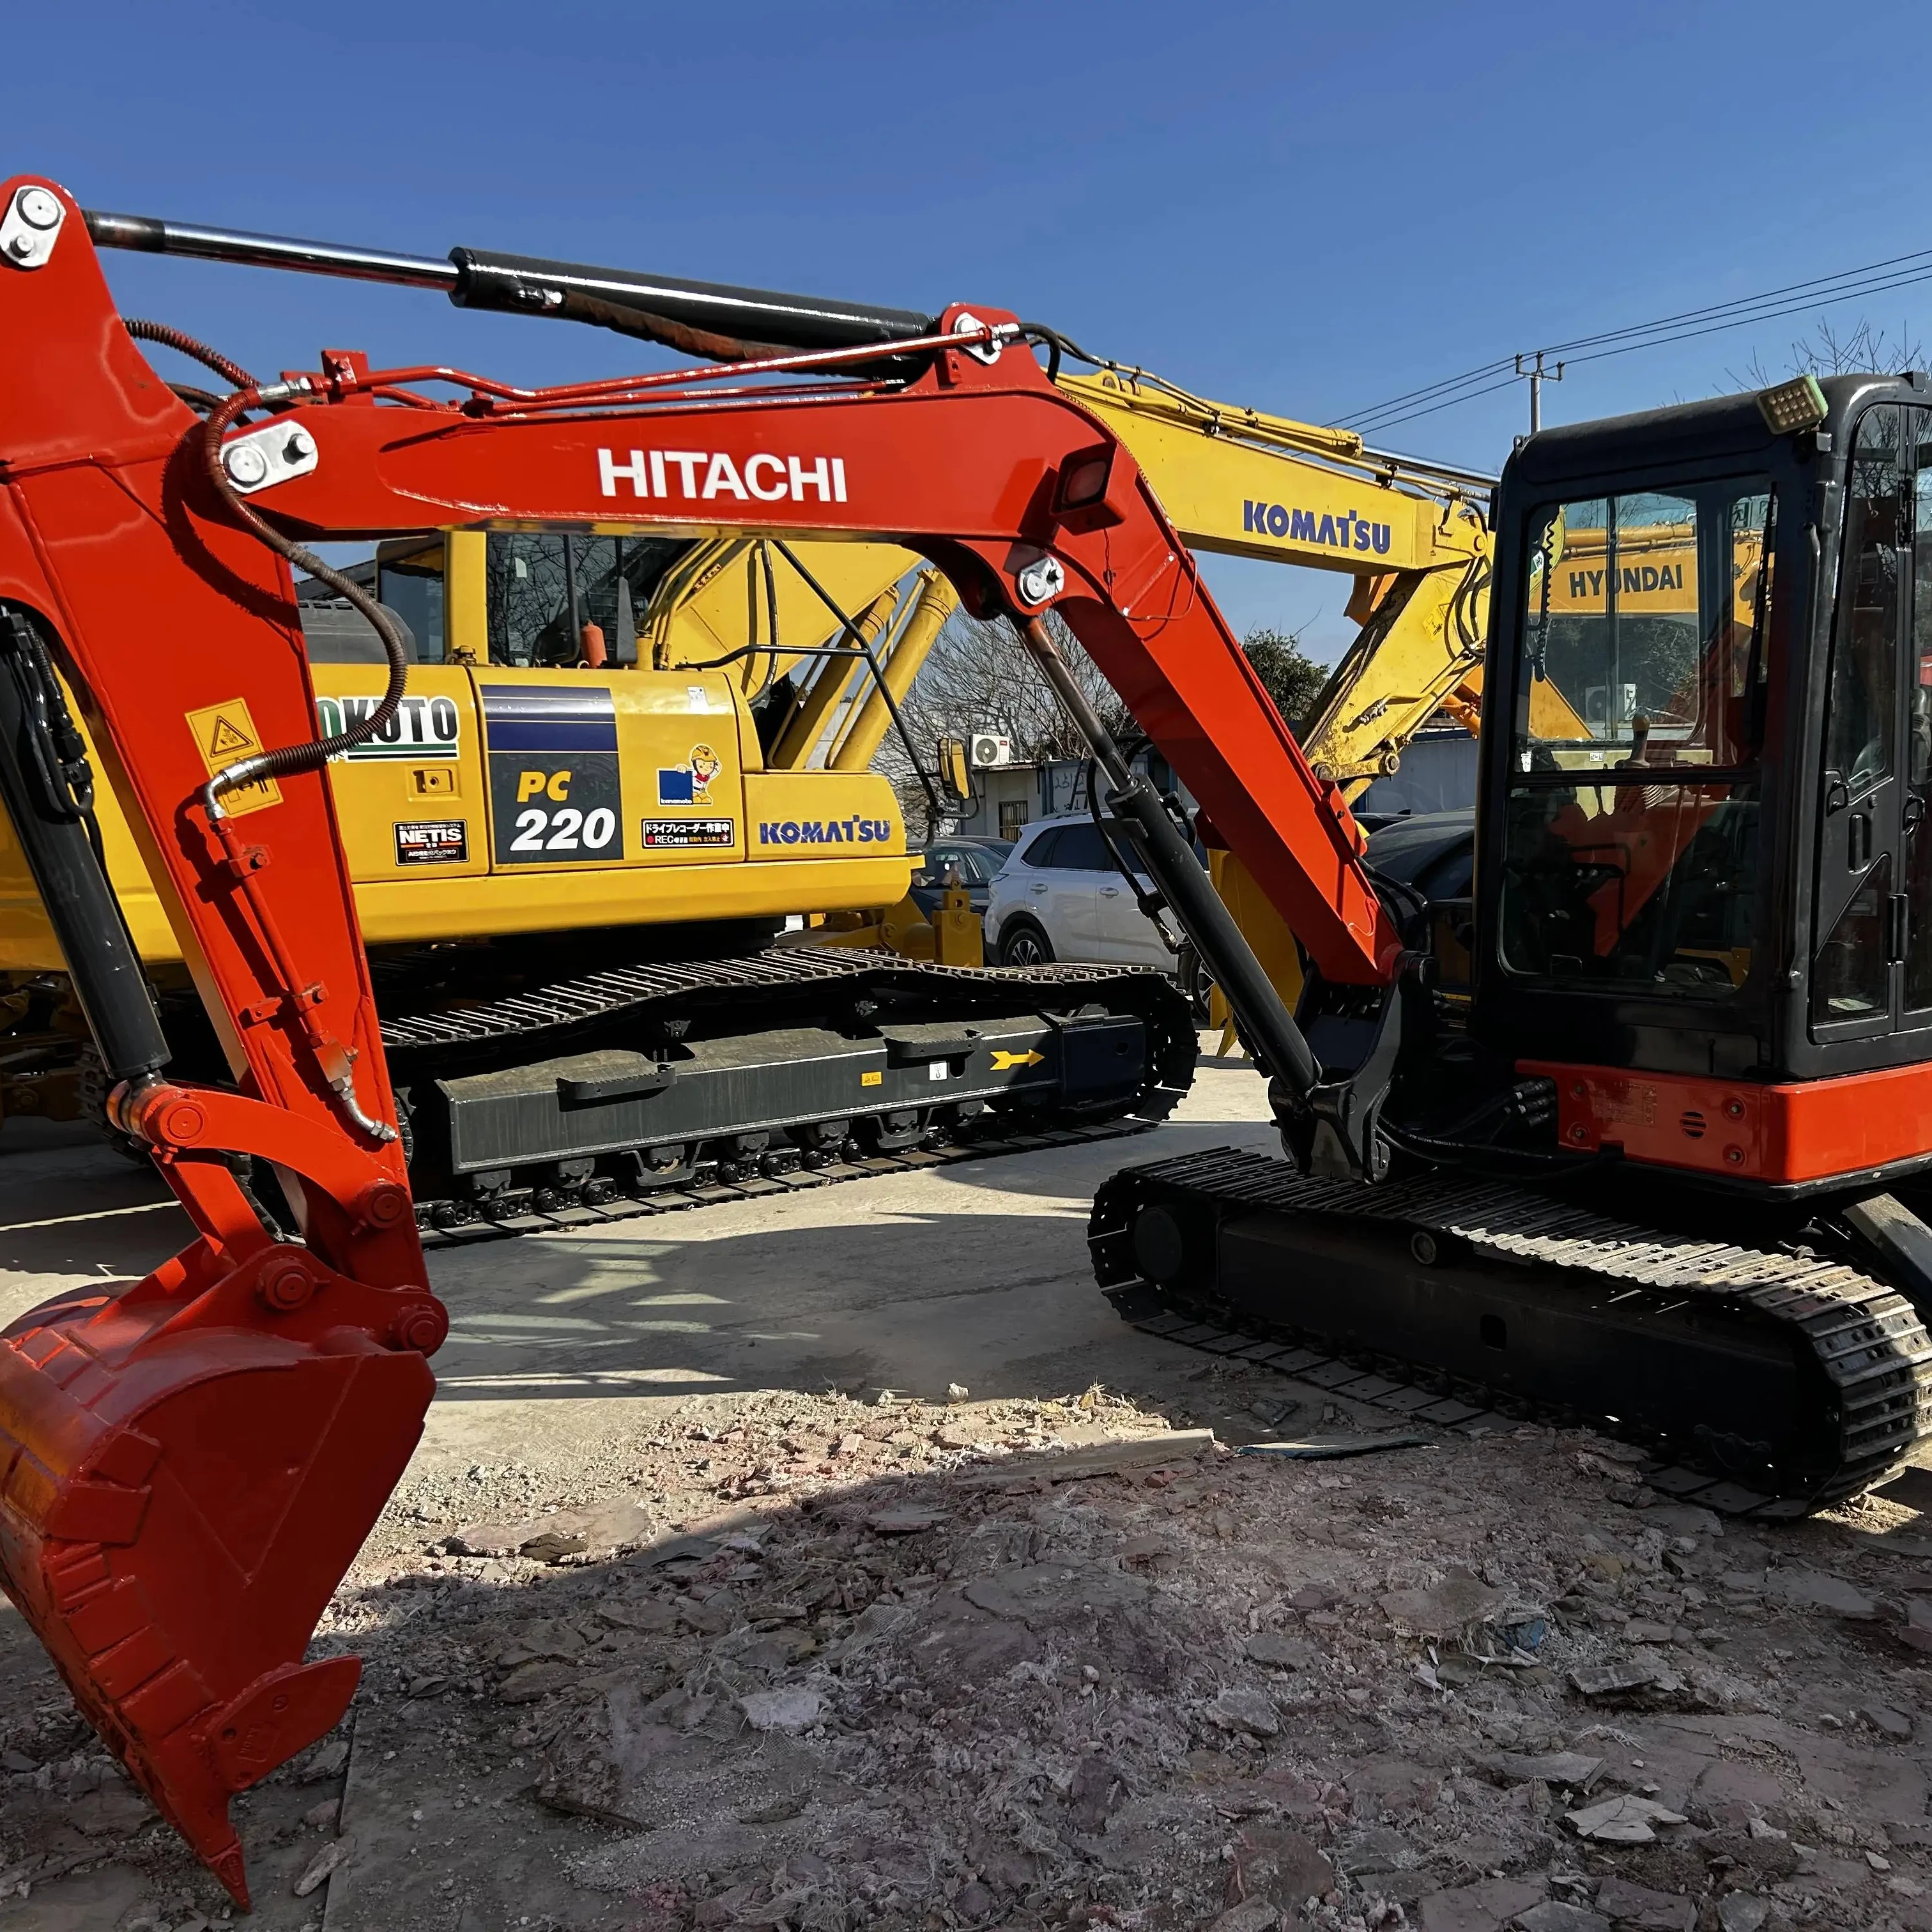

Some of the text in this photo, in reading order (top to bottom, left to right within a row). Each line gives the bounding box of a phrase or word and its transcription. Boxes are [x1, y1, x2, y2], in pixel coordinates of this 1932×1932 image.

[597, 448, 847, 503] HITACHI
[1243, 500, 1391, 555] KOMATSU
[1569, 564, 1682, 598] HYUNDAI
[517, 770, 572, 802] PC
[399, 828, 462, 843] NETIS
[509, 808, 616, 851] 220
[759, 815, 891, 844] KOMATSU
